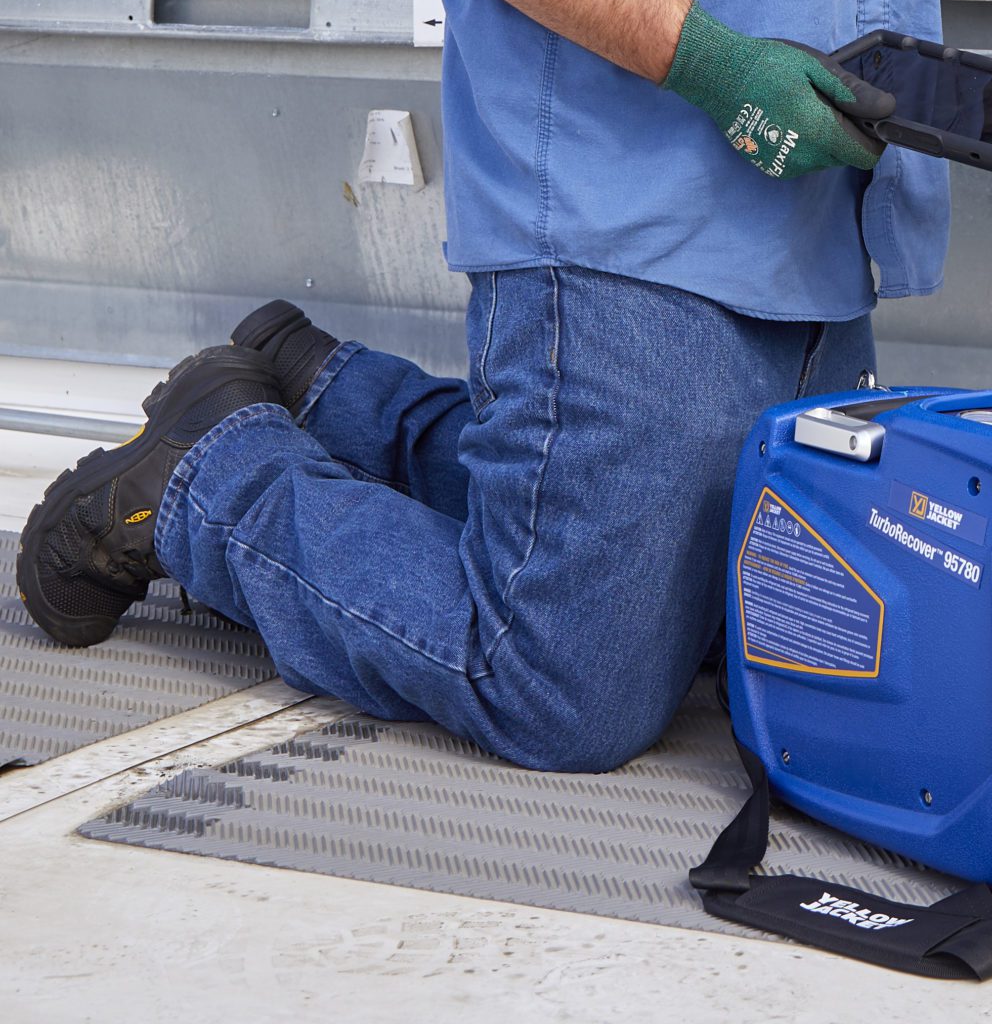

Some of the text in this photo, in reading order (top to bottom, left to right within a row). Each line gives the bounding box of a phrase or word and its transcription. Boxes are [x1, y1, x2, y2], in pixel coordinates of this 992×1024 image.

[926, 510, 961, 530] JACKET
[928, 501, 963, 522] YELLOW
[943, 551, 980, 583] 95780
[799, 901, 888, 930] JACKET
[818, 891, 915, 928] YELLOW
